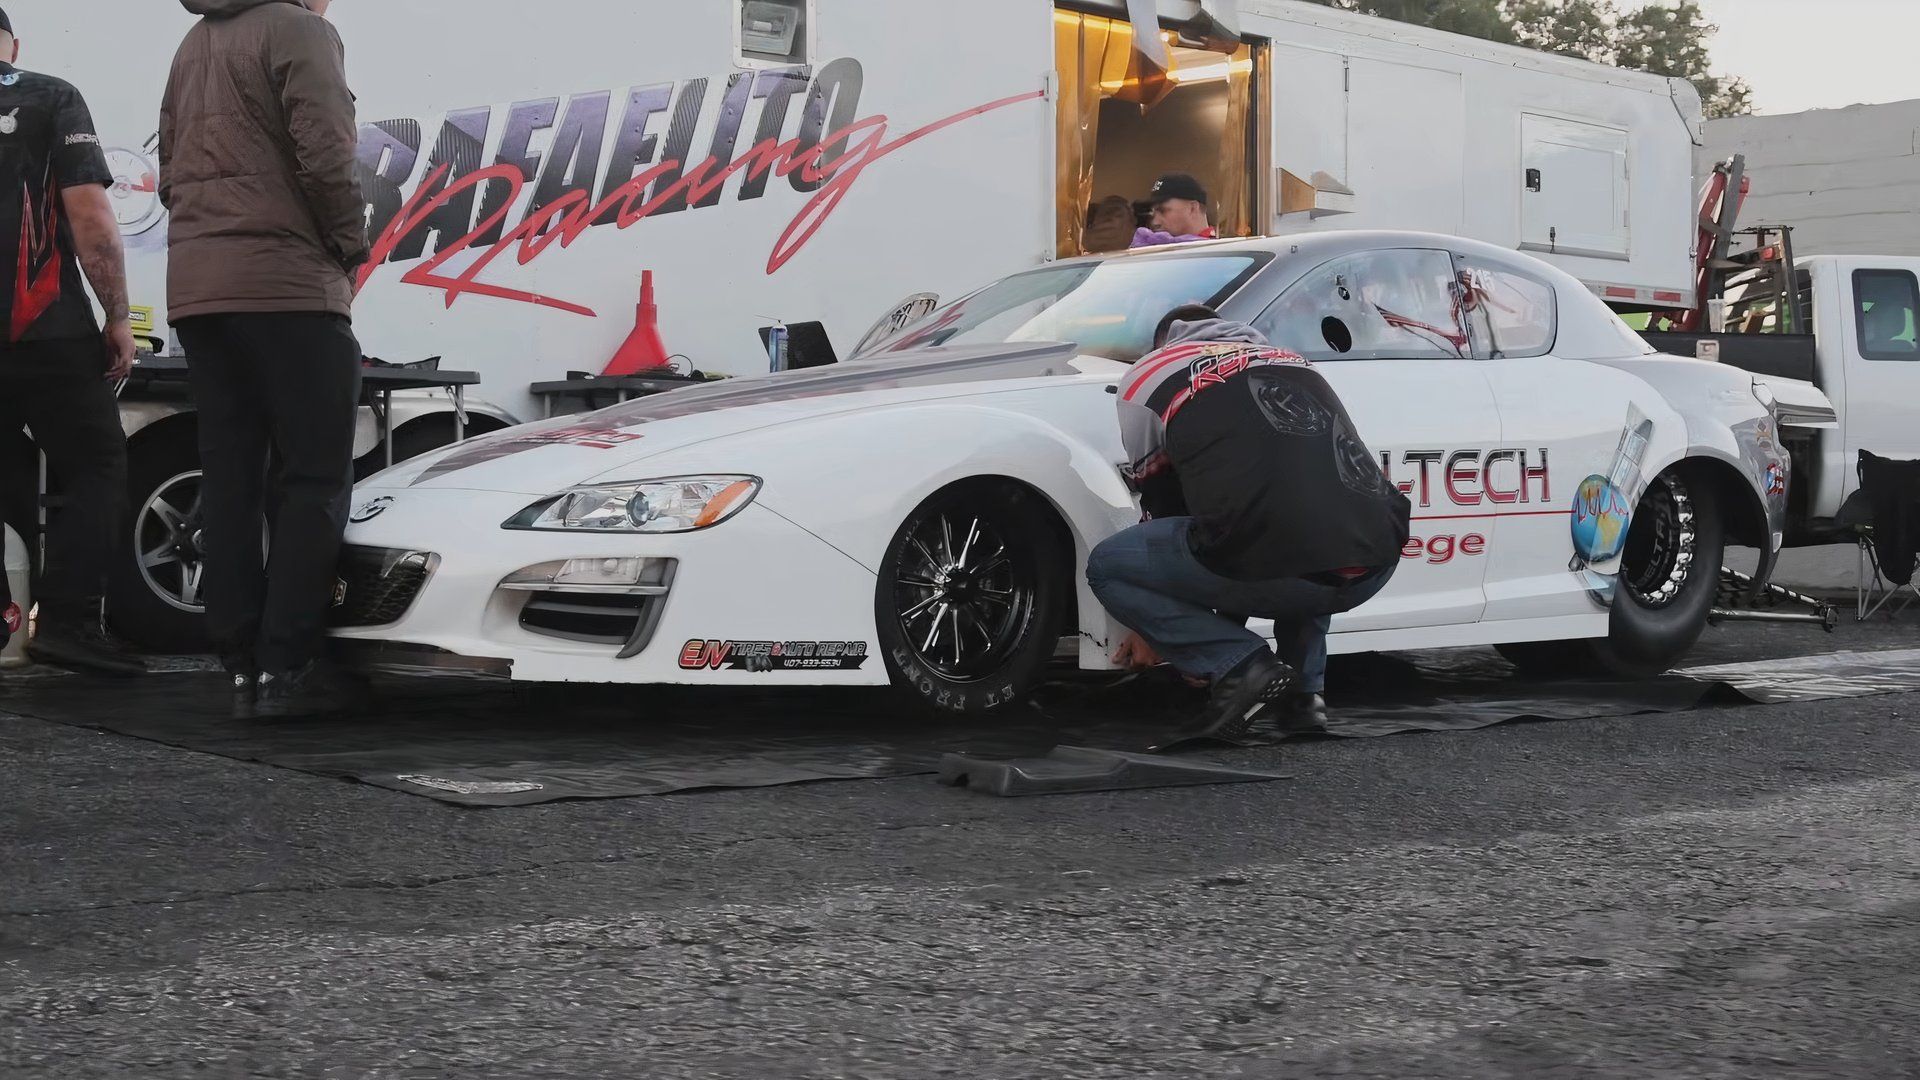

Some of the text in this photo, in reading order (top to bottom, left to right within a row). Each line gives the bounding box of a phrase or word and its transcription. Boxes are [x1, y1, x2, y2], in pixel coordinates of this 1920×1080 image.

[351, 90, 1044, 317] Racing
[353, 57, 864, 266] RAFAELITO
[816, 641, 867, 656] REPAIR
